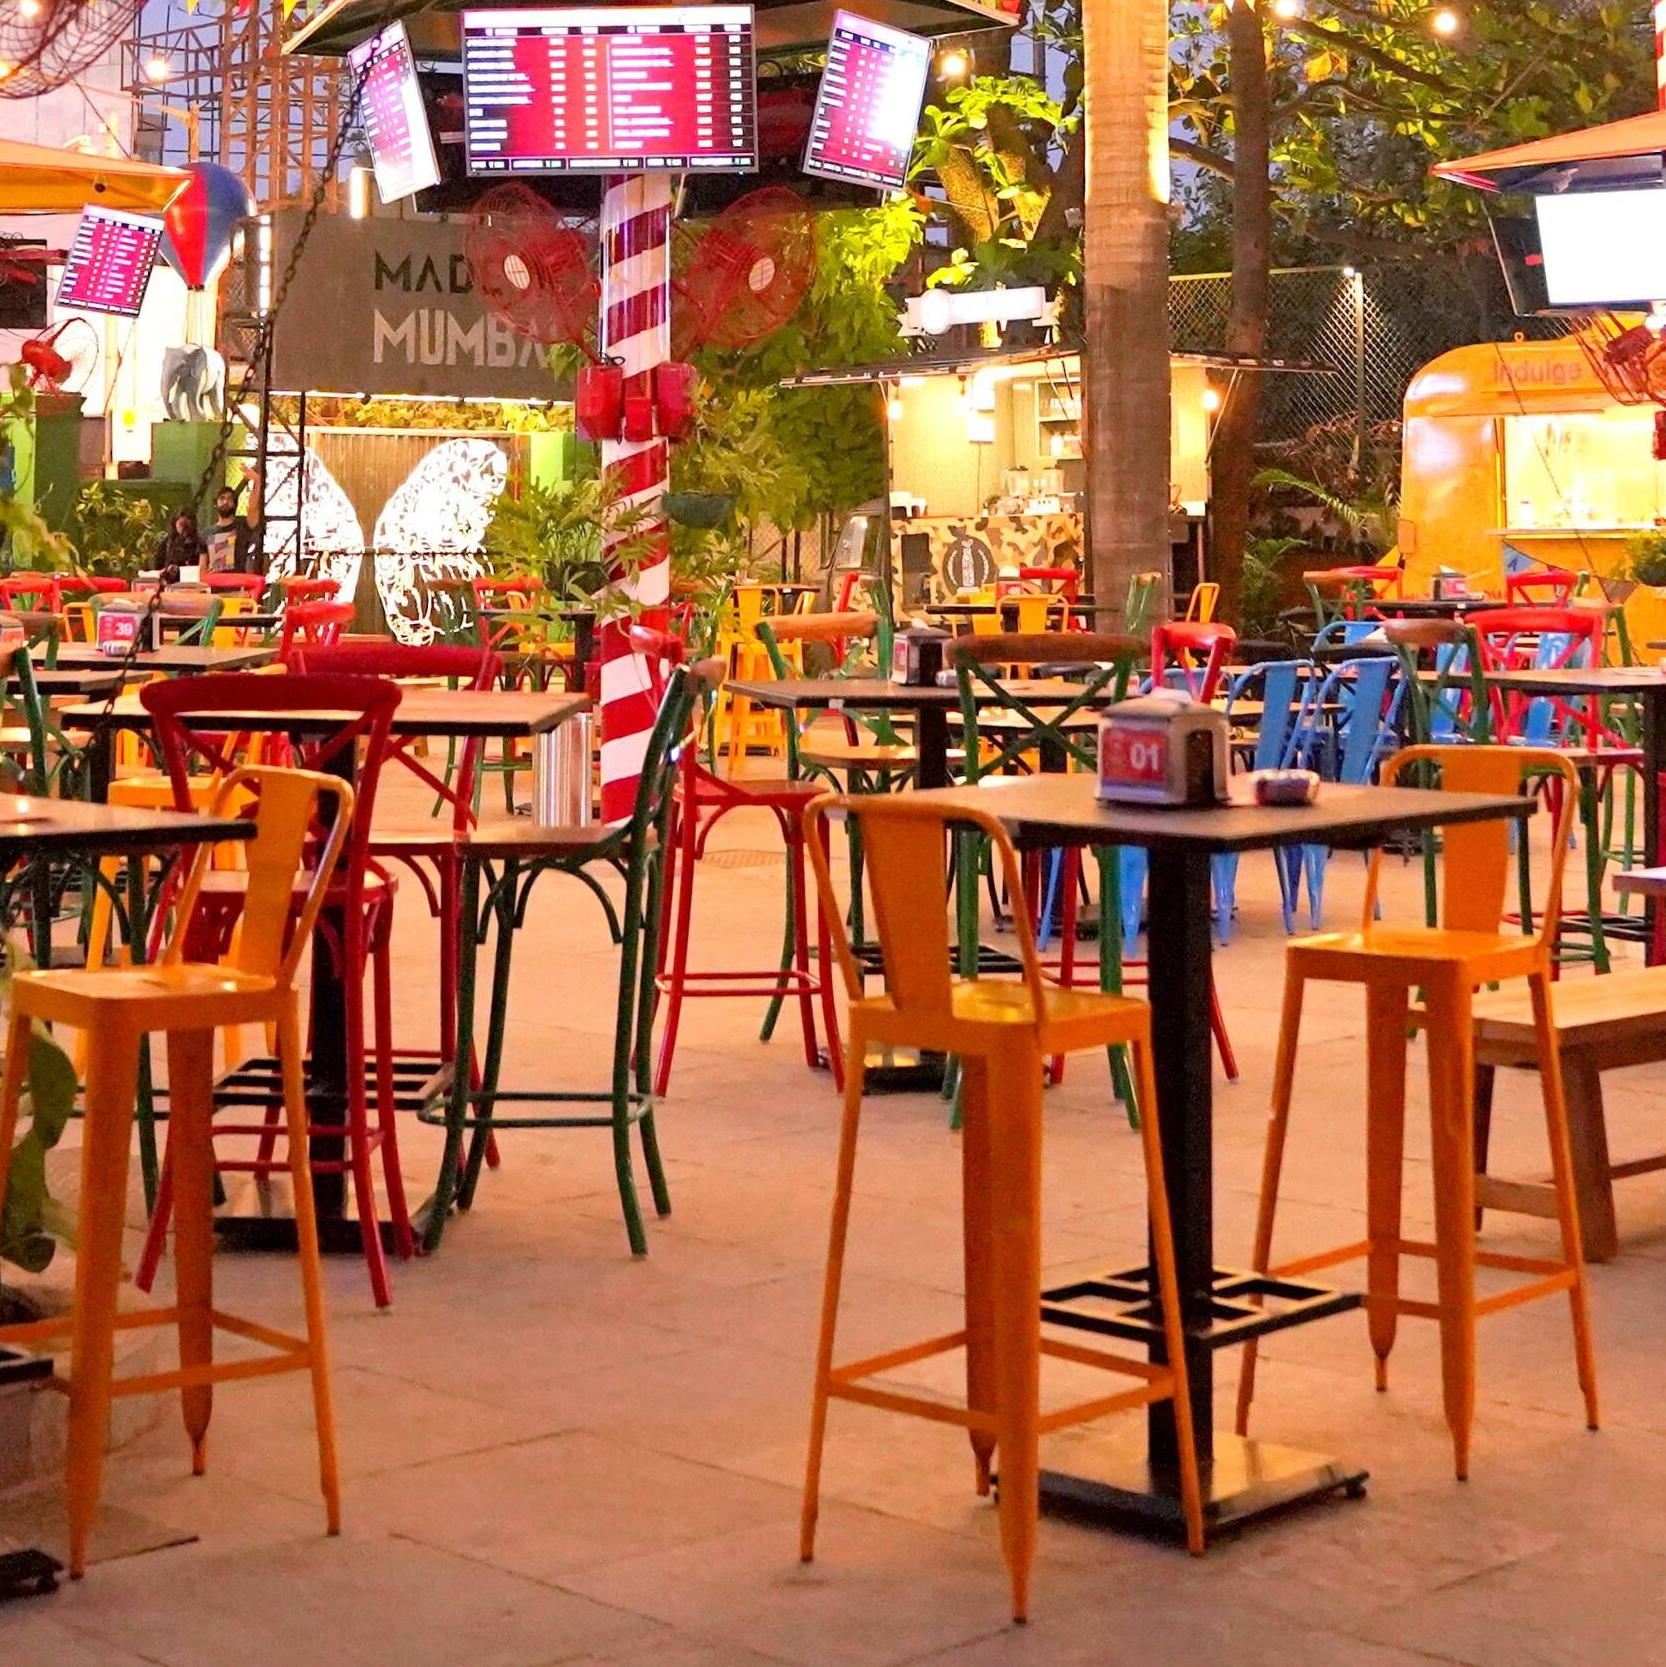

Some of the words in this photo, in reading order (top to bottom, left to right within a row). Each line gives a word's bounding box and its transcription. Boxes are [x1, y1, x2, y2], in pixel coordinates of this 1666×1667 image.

[374, 250, 483, 297] MAD
[1494, 359, 1582, 385] Indulge
[115, 622, 132, 636] 39
[1129, 742, 1161, 771] 01
